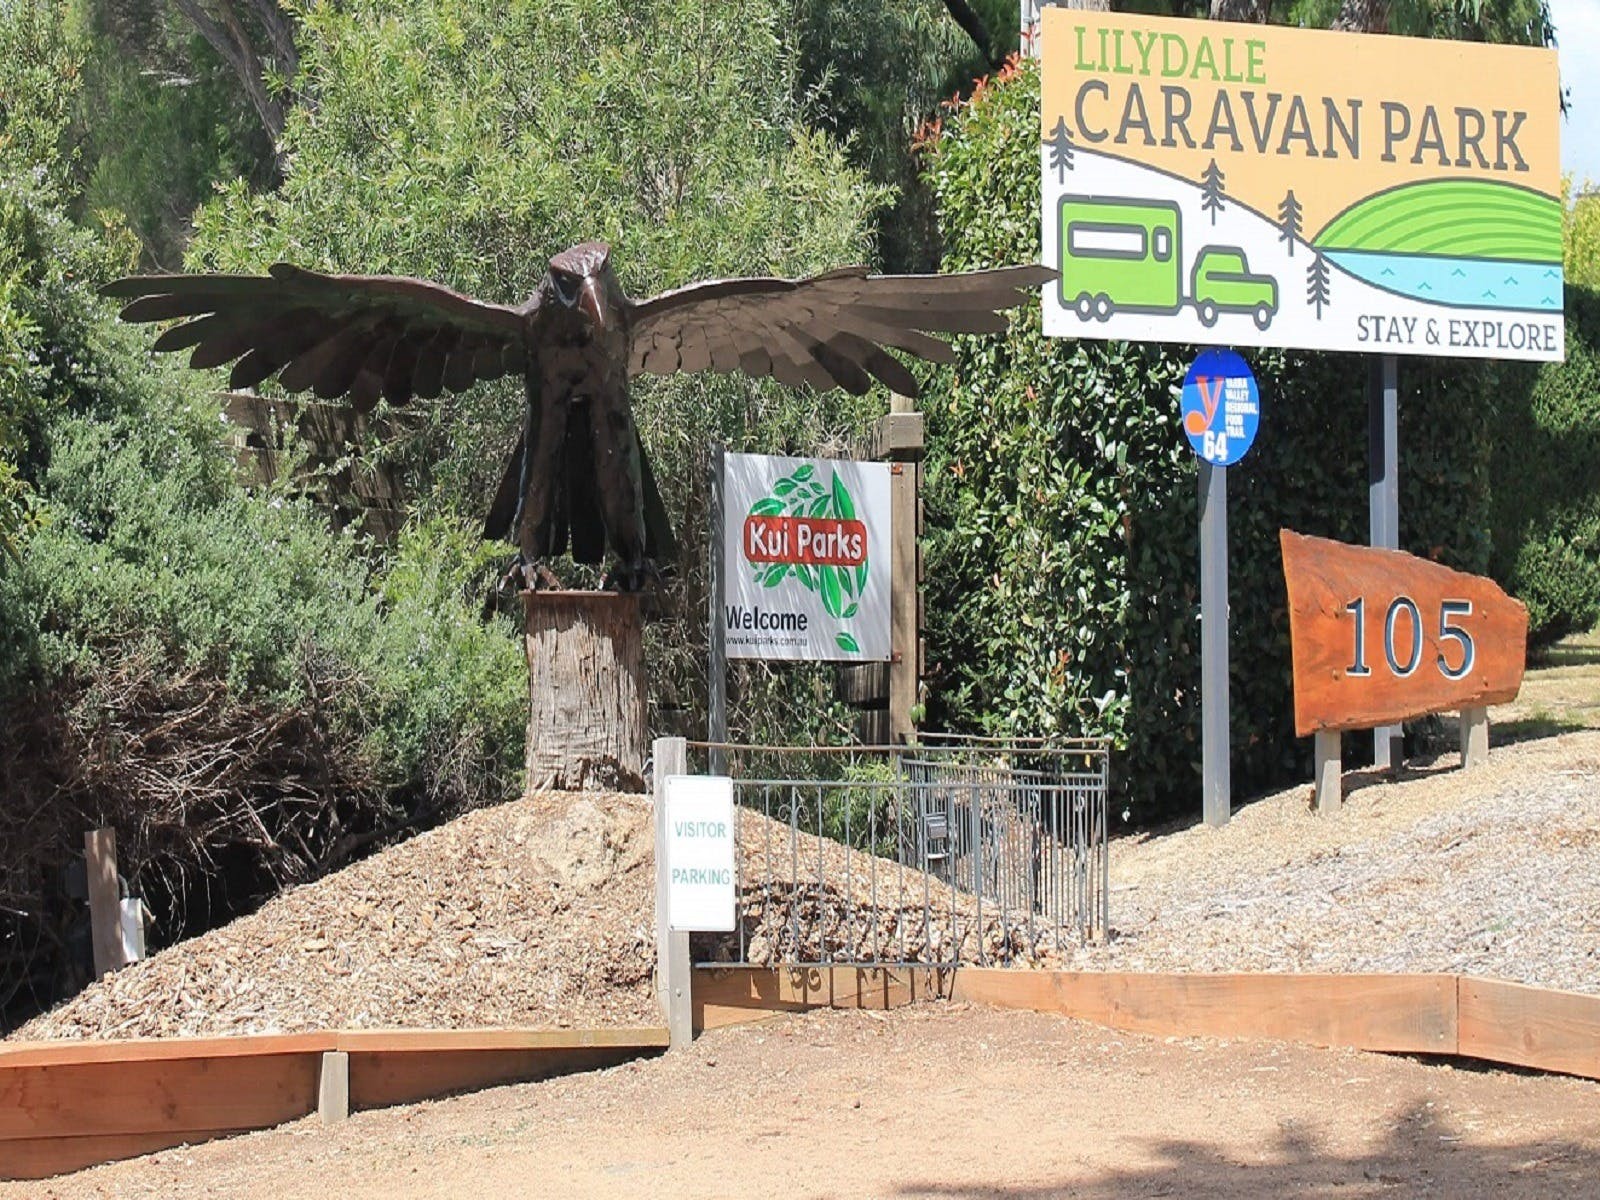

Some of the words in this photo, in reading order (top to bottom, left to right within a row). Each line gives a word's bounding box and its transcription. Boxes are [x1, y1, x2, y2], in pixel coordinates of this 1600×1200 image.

[1074, 26, 1267, 84] LILYDALE
[1074, 79, 1364, 160] CARAVAN
[1380, 101, 1530, 172] PARK
[1357, 314, 1421, 346] STAY
[1425, 322, 1440, 346] &
[1448, 319, 1557, 352] EXPLORE
[1203, 431, 1228, 462] 64
[750, 522, 789, 557] Kui
[798, 524, 863, 560] Parks
[725, 605, 808, 631] Welcome
[1345, 595, 1475, 680] 105
[674, 821, 726, 838] VISITOR
[672, 868, 730, 885] PARKING
